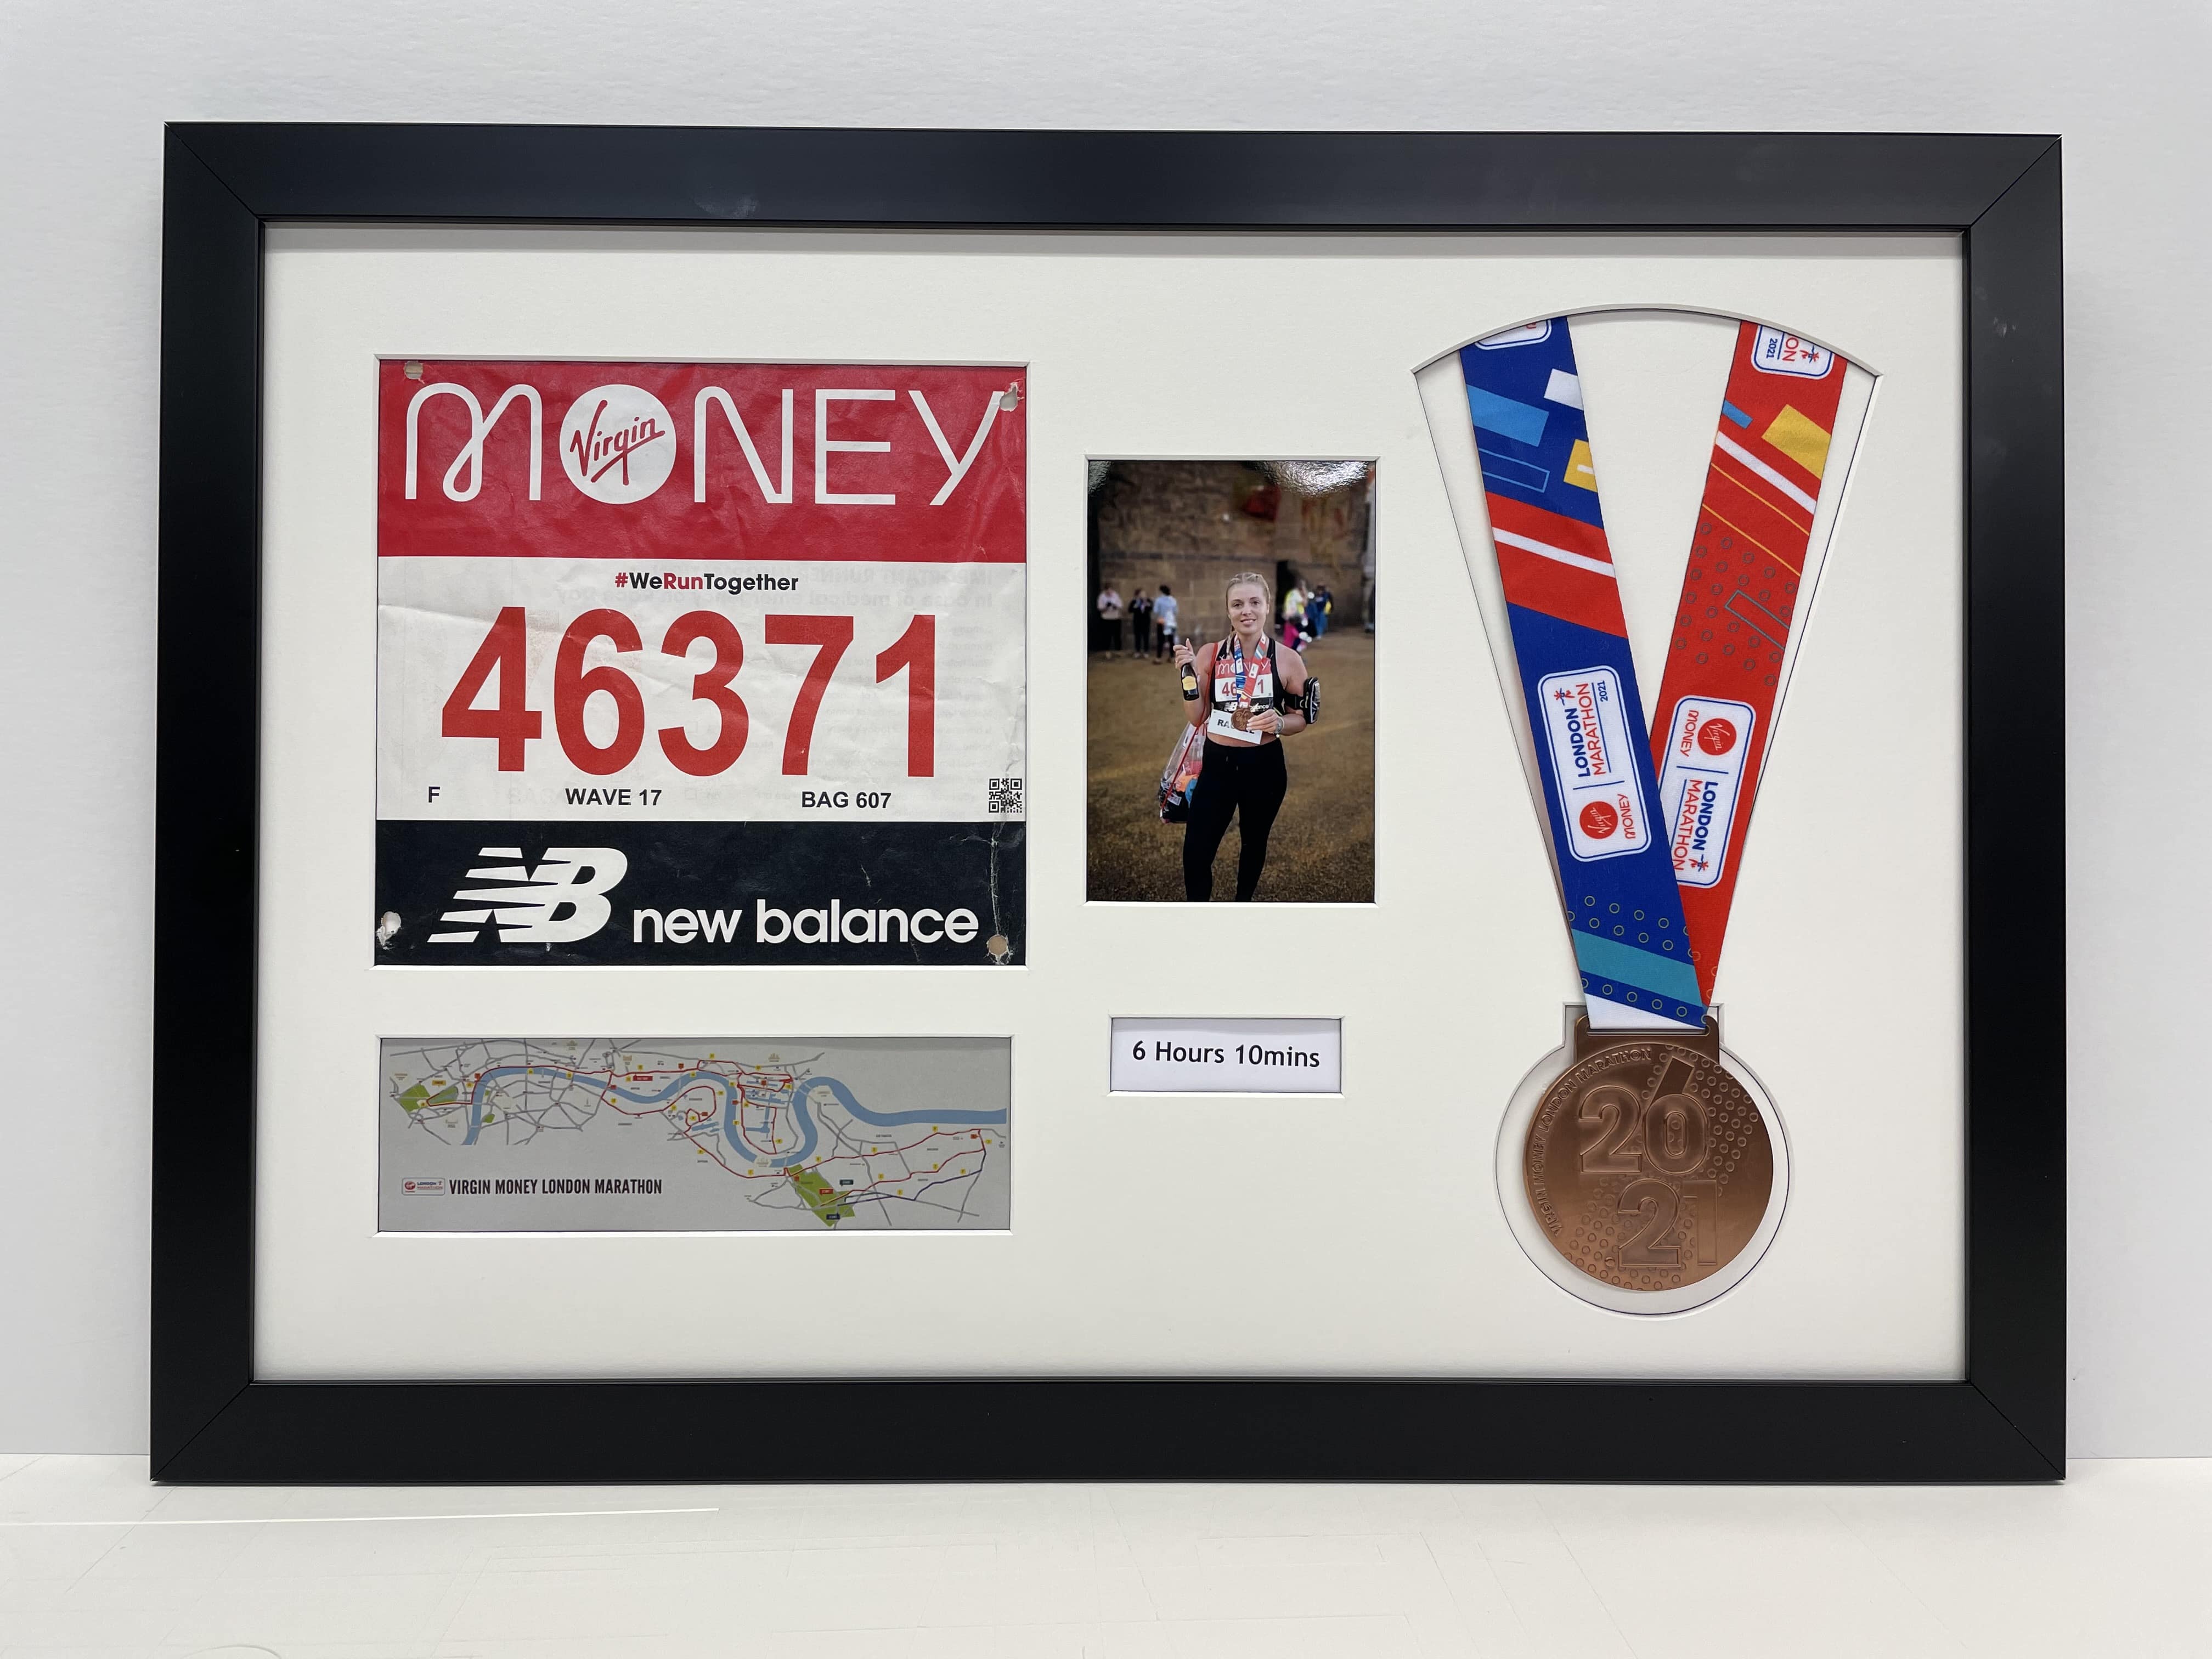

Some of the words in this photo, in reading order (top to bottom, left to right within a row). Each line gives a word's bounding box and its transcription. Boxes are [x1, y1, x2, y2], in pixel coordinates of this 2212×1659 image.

[1766, 338, 1778, 359] 2021
[569, 400, 665, 486] Virgin
[614, 572, 799, 594] #WeRunTogether
[442, 606, 935, 777] 46371
[1597, 680, 1609, 702] 2021
[1565, 708, 1591, 777] LONDON
[1576, 682, 1607, 776] MARATHON
[1680, 710, 1699, 757] MONEY
[1703, 723, 1730, 751] Virgin
[428, 786, 440, 803] F
[566, 788, 631, 805] WAVE
[639, 789, 662, 806] 17
[802, 791, 849, 808] BAG
[856, 792, 891, 809] 607
[1617, 793, 1636, 839] MONEY
[1692, 781, 1719, 851] LONDON
[1588, 807, 1613, 834] Virgin
[1673, 780, 1703, 871] MARATHON
[427, 847, 628, 943] NB
[633, 909, 742, 944] new
[757, 899, 979, 944] balance
[1132, 1040, 1146, 1060] 6
[1155, 1041, 1224, 1064] Hours
[1235, 1044, 1321, 1068] 10mins
[1575, 1048, 1651, 1085] MARATHON
[1538, 1077, 1577, 1132] LONDON
[1532, 1135, 1547, 1186] MONEY
[449, 1179, 490, 1194] VIRGIN
[495, 1179, 538, 1194] MONEY
[541, 1179, 590, 1194] LONDON
[594, 1179, 663, 1195] MARATHON
[1534, 1188, 1563, 1237] VIRGIN
[1617, 1179, 1717, 1267] 21
